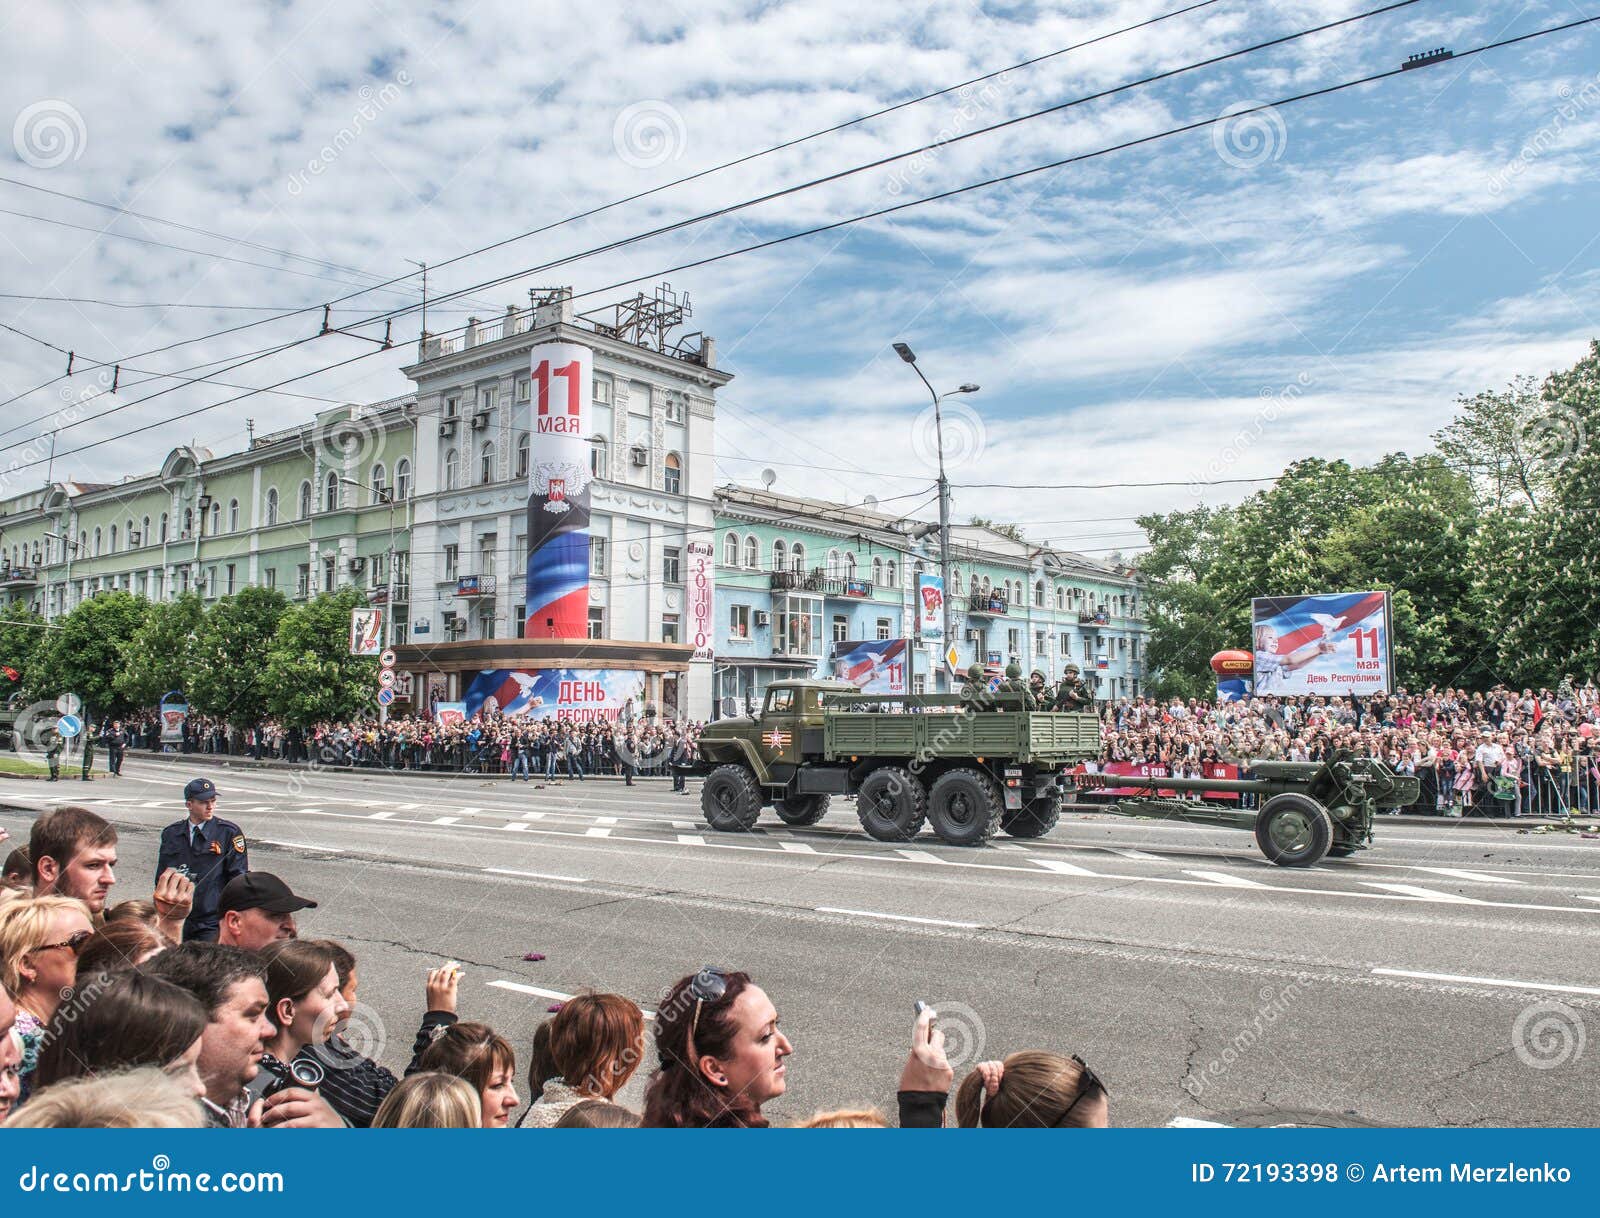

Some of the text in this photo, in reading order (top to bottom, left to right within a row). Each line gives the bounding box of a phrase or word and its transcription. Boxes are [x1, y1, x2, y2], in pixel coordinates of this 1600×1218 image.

[531, 359, 580, 416] 11
[537, 416, 580, 434] мая
[695, 558, 706, 648] ЗОЛОТО
[1348, 627, 1379, 659] 11
[886, 662, 902, 683] 11
[1356, 660, 1380, 670] мая
[1306, 673, 1381, 684] День Республики
[557, 680, 606, 705] ДЕНЬ
